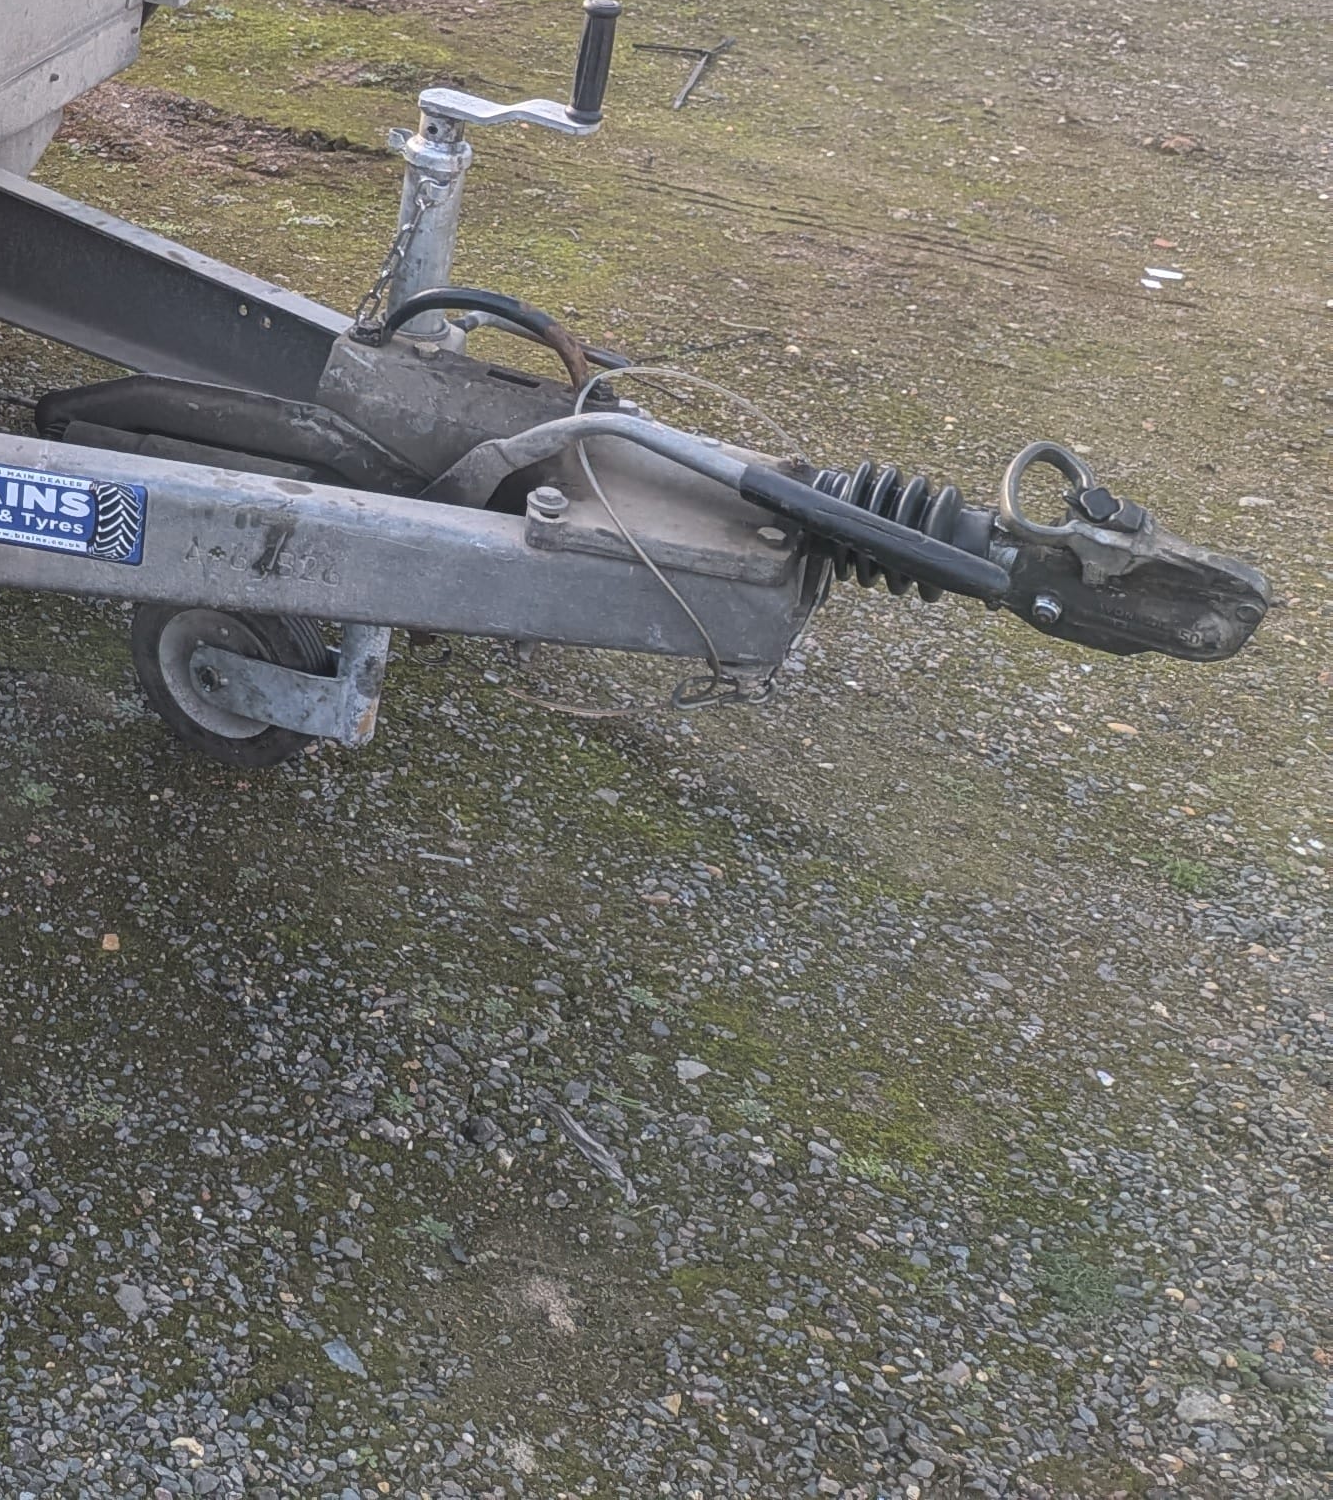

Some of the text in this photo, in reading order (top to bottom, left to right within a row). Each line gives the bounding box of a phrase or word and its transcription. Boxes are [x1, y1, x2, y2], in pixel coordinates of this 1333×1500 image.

[6, 470, 35, 480] MAIN
[39, 476, 83, 487] DEALER
[21, 512, 84, 535] Tyres
